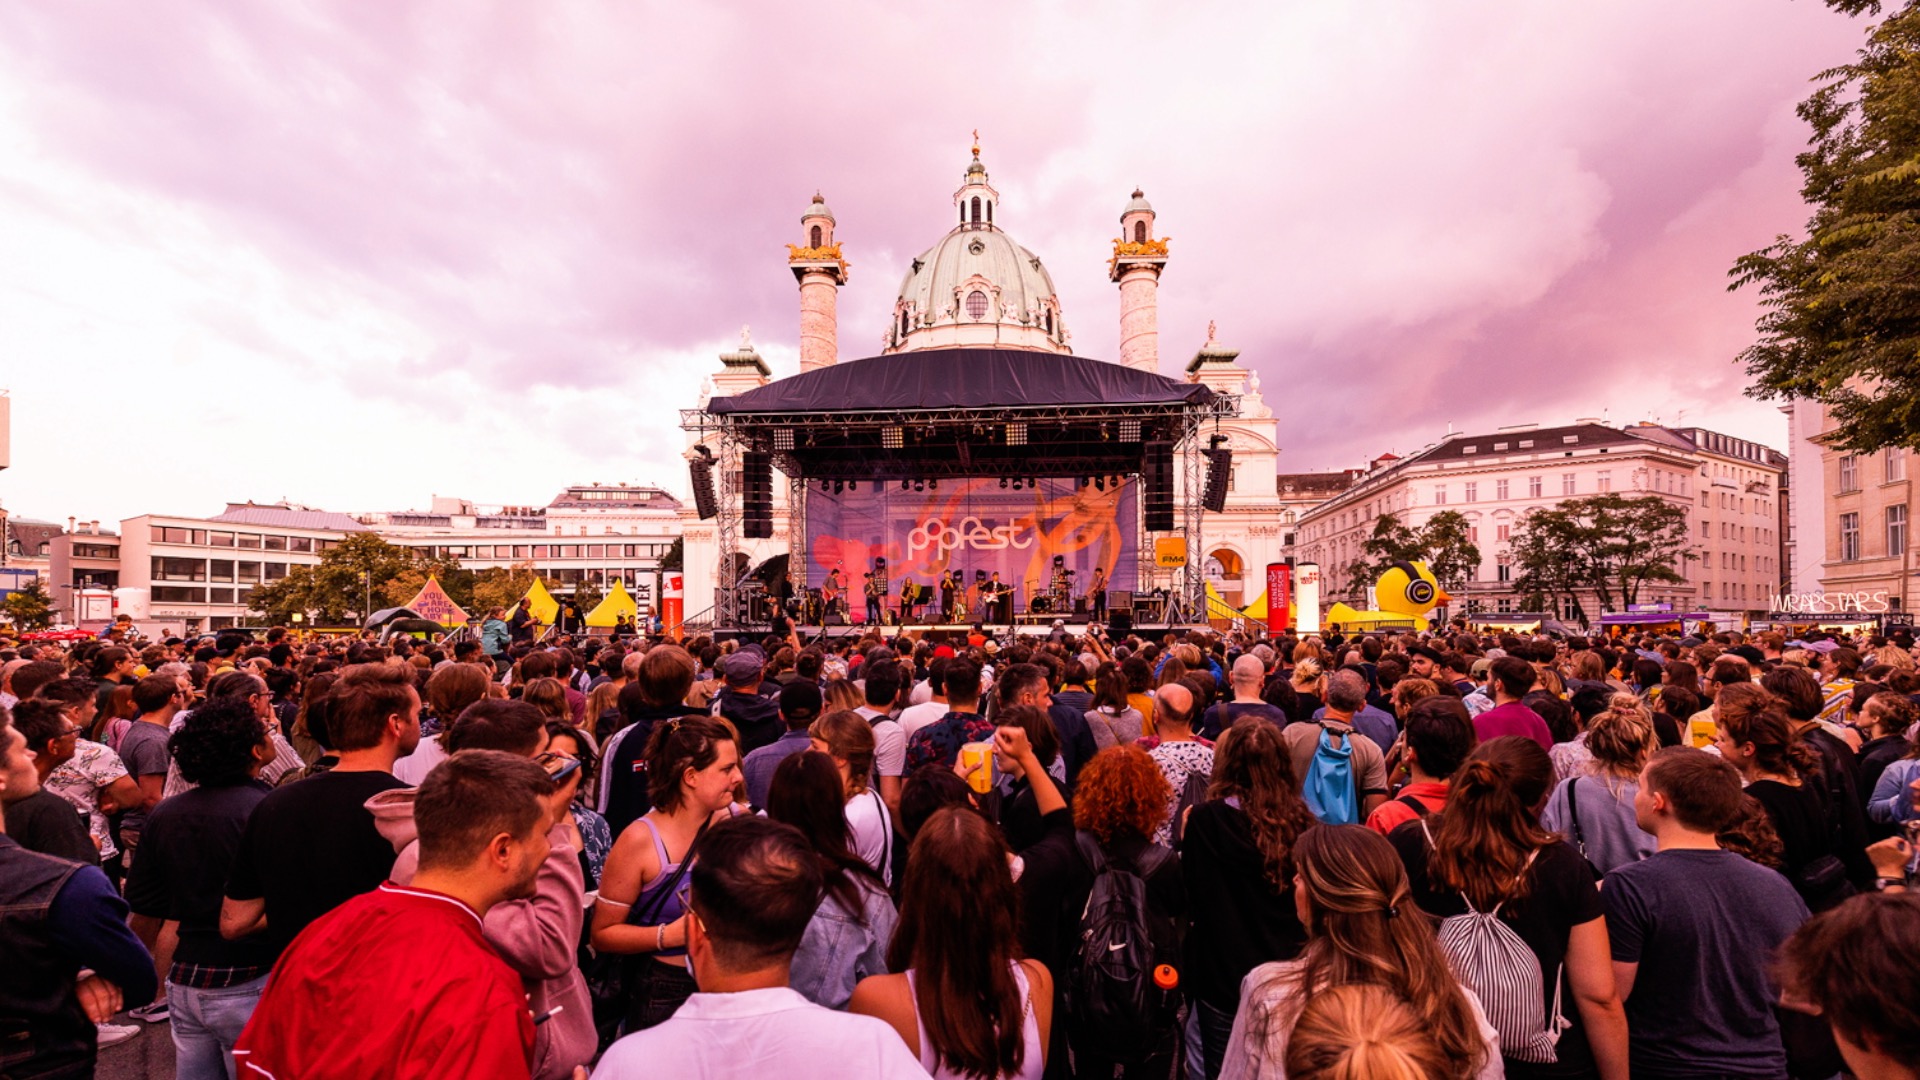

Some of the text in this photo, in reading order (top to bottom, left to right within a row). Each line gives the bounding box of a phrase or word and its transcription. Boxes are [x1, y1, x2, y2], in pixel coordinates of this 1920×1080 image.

[908, 516, 1033, 561] popfest
[1162, 555, 1185, 563] FM4
[423, 592, 442, 600] YOU
[431, 600, 449, 608] ARE
[1770, 591, 1889, 613] WRAPSTARS
